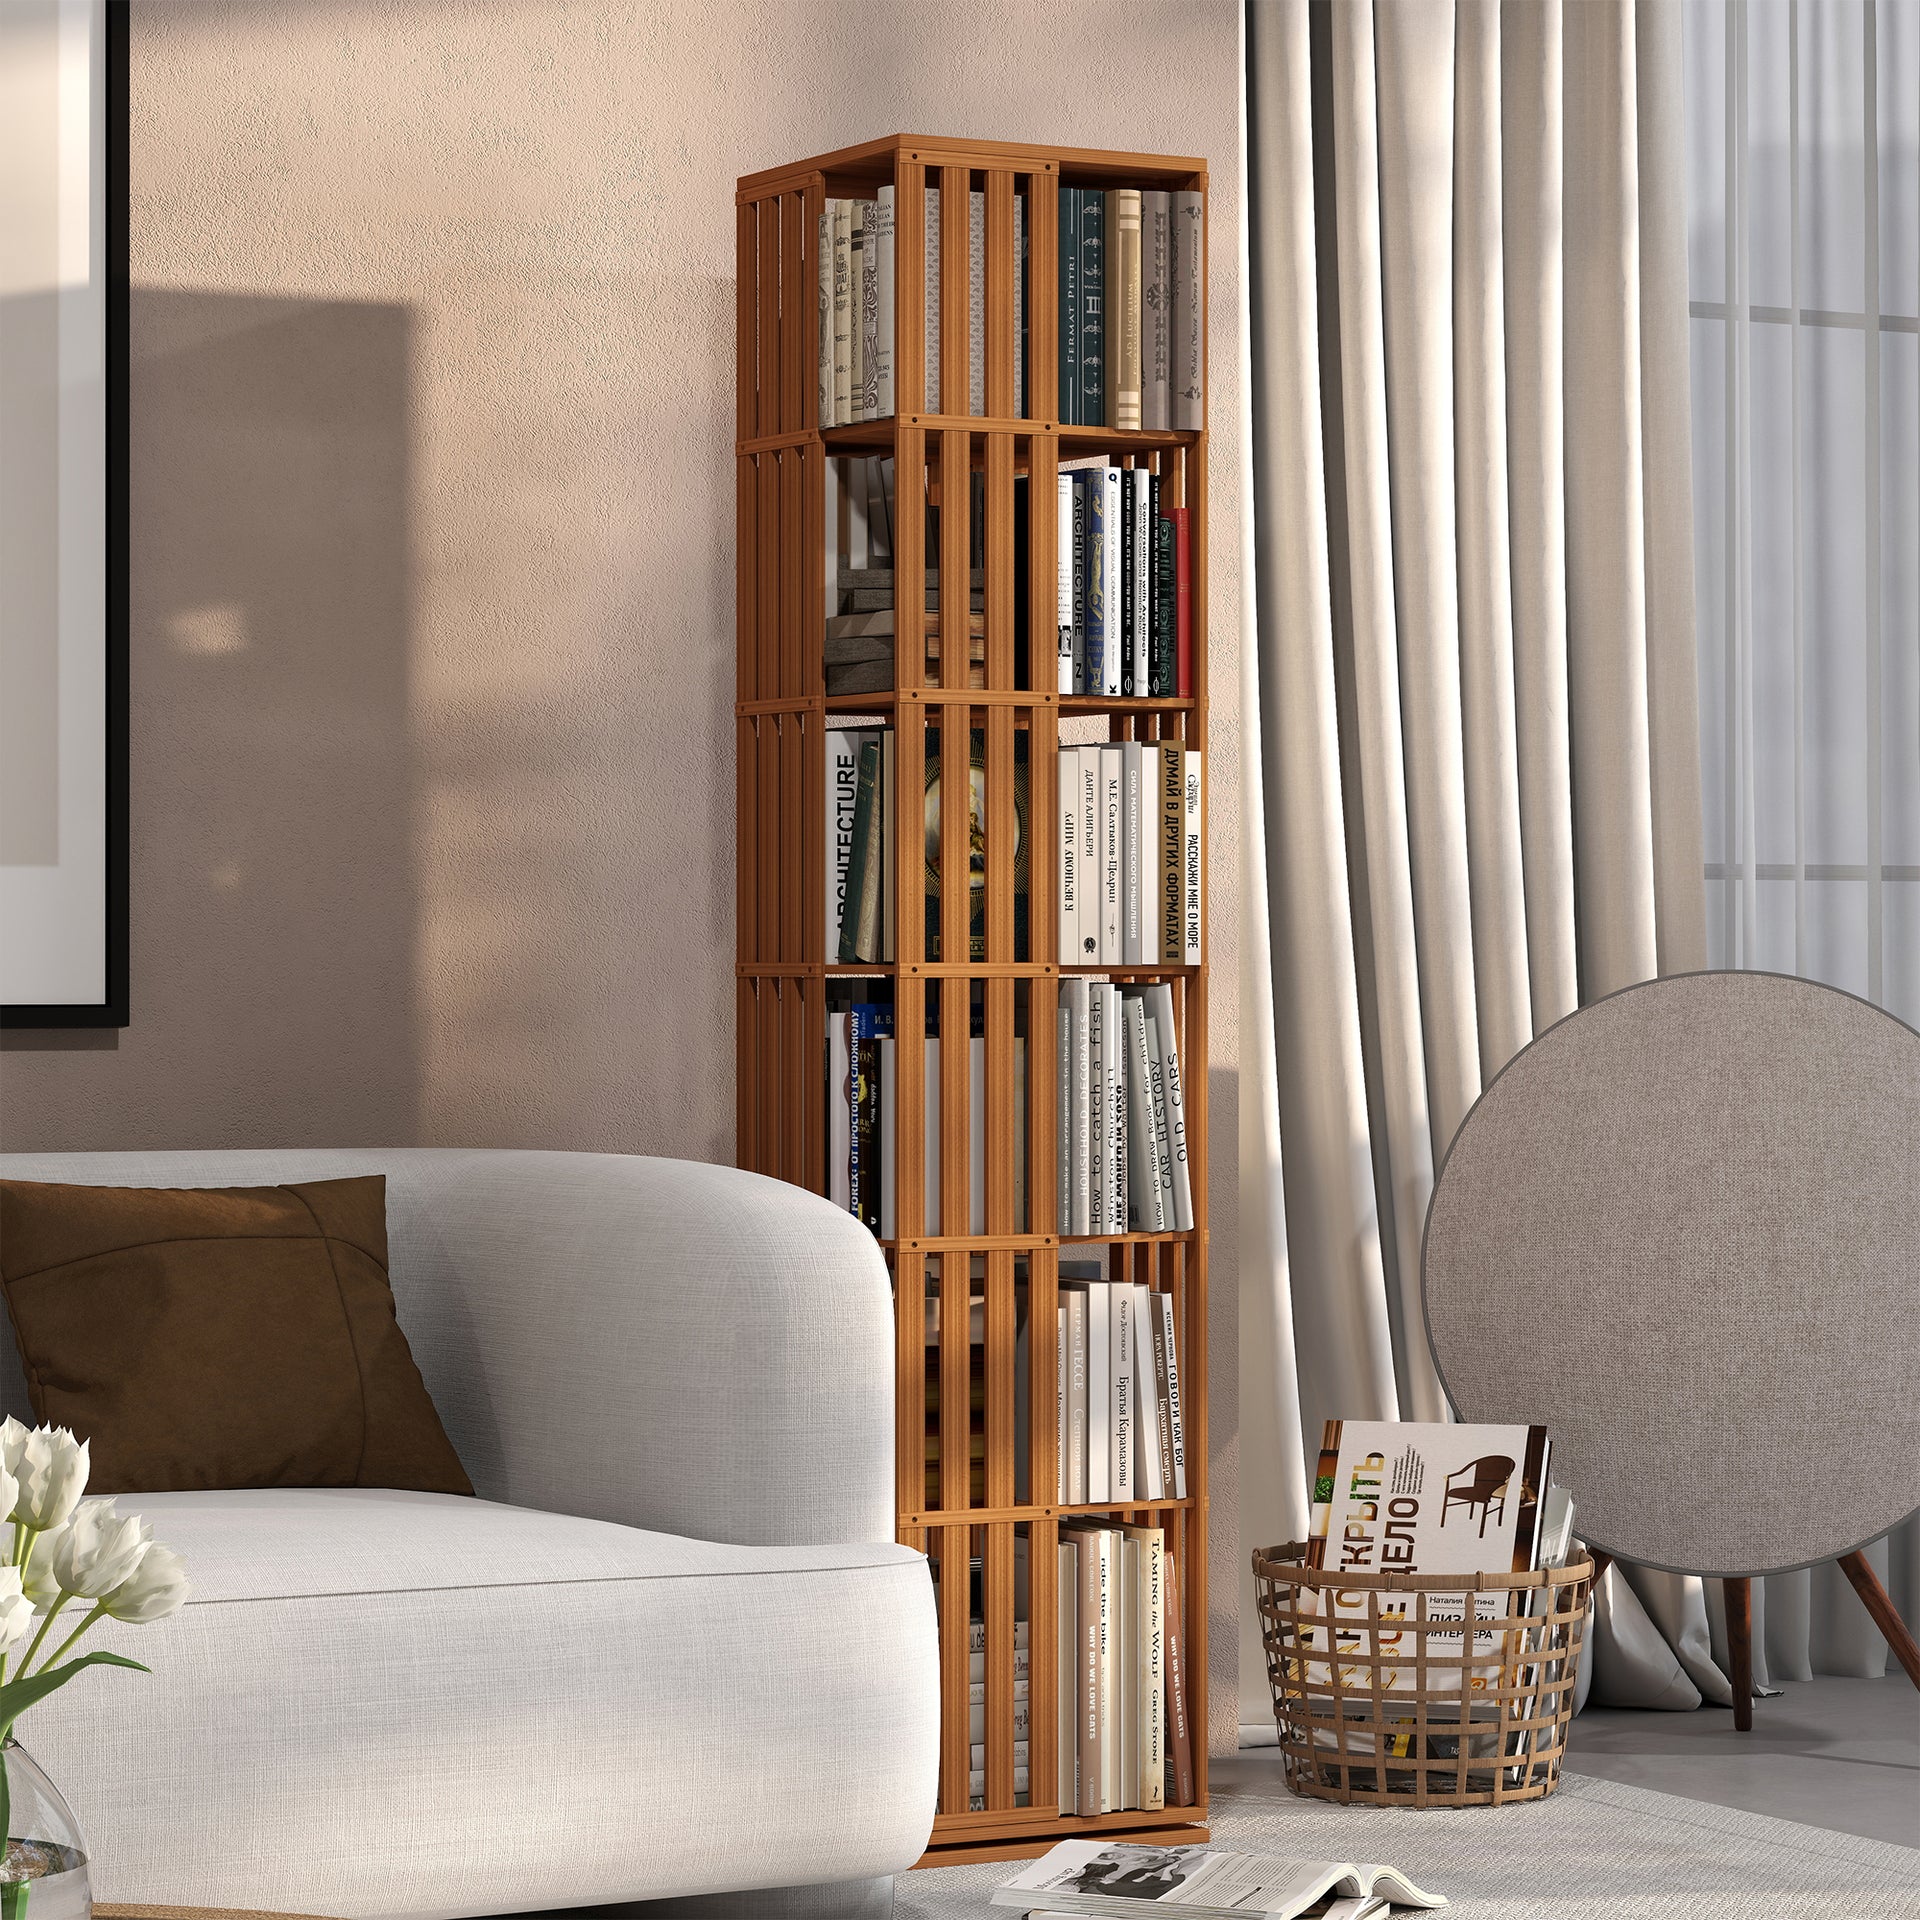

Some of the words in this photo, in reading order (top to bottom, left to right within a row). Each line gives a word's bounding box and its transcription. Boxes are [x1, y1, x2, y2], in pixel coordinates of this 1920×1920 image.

[1110, 536, 1116, 546] OF
[1074, 495, 1084, 636] ARCHITECTURE
[1085, 770, 1094, 803] ДАНТЕ
[1164, 748, 1182, 797] ДУМАЙ
[1109, 779, 1118, 802] М.Е.
[1166, 802, 1178, 810] В
[837, 754, 855, 929] HITECTURE
[1065, 811, 1074, 845] МИРУ
[1085, 805, 1094, 856] АЛИГЬЕРИ
[1164, 814, 1178, 868] ДРУГИХ
[1065, 849, 1074, 901] ВЕЧНОМУ
[1188, 834, 1198, 886] РАССКАЖИ
[1166, 872, 1179, 946] ФОРМАТАХ
[1188, 888, 1198, 910] МНЕ
[1188, 922, 1198, 948] МОРЕ
[1090, 1002, 1100, 1046] fish
[1137, 1004, 1148, 1066] children
[1064, 1068, 1069, 1078] in
[1080, 1014, 1088, 1100] DECORATES
[1094, 1061, 1100, 1070] a
[1168, 1053, 1182, 1107] CARS
[1090, 1084, 1100, 1142] catch
[1151, 1060, 1168, 1142] HISTORY
[1146, 1104, 1154, 1134] Book
[852, 1149, 859, 1164] ОТ
[1064, 1150, 1069, 1160] an
[1080, 1110, 1088, 1196] HOUSEHOLD
[1122, 1135, 1127, 1150] by
[1149, 1141, 1158, 1172] DRAW
[1174, 1122, 1187, 1162] OLD
[1092, 1154, 1100, 1176] to
[1160, 1154, 1174, 1190] CAR
[1064, 1193, 1069, 1204] to
[1153, 1180, 1160, 1194] TO
[1091, 1189, 1100, 1224] How
[1074, 1349, 1084, 1391] ГЕССЕ
[1116, 1376, 1130, 1416] Братья
[1168, 1364, 1180, 1418] ГОВОРИ
[1158, 1398, 1170, 1450] Бархатная
[1174, 1422, 1182, 1444] КАК
[1116, 1418, 1130, 1486] Карамазовы
[1162, 1450, 1172, 1484] смерть
[1176, 1448, 1184, 1468] БОГ
[1429, 1596, 1463, 1605] Наталия
[1090, 1652, 1096, 1665] DO
[1172, 1658, 1179, 1672] DO
[1090, 1668, 1096, 1684] WE
[1174, 1674, 1181, 1688] WE
